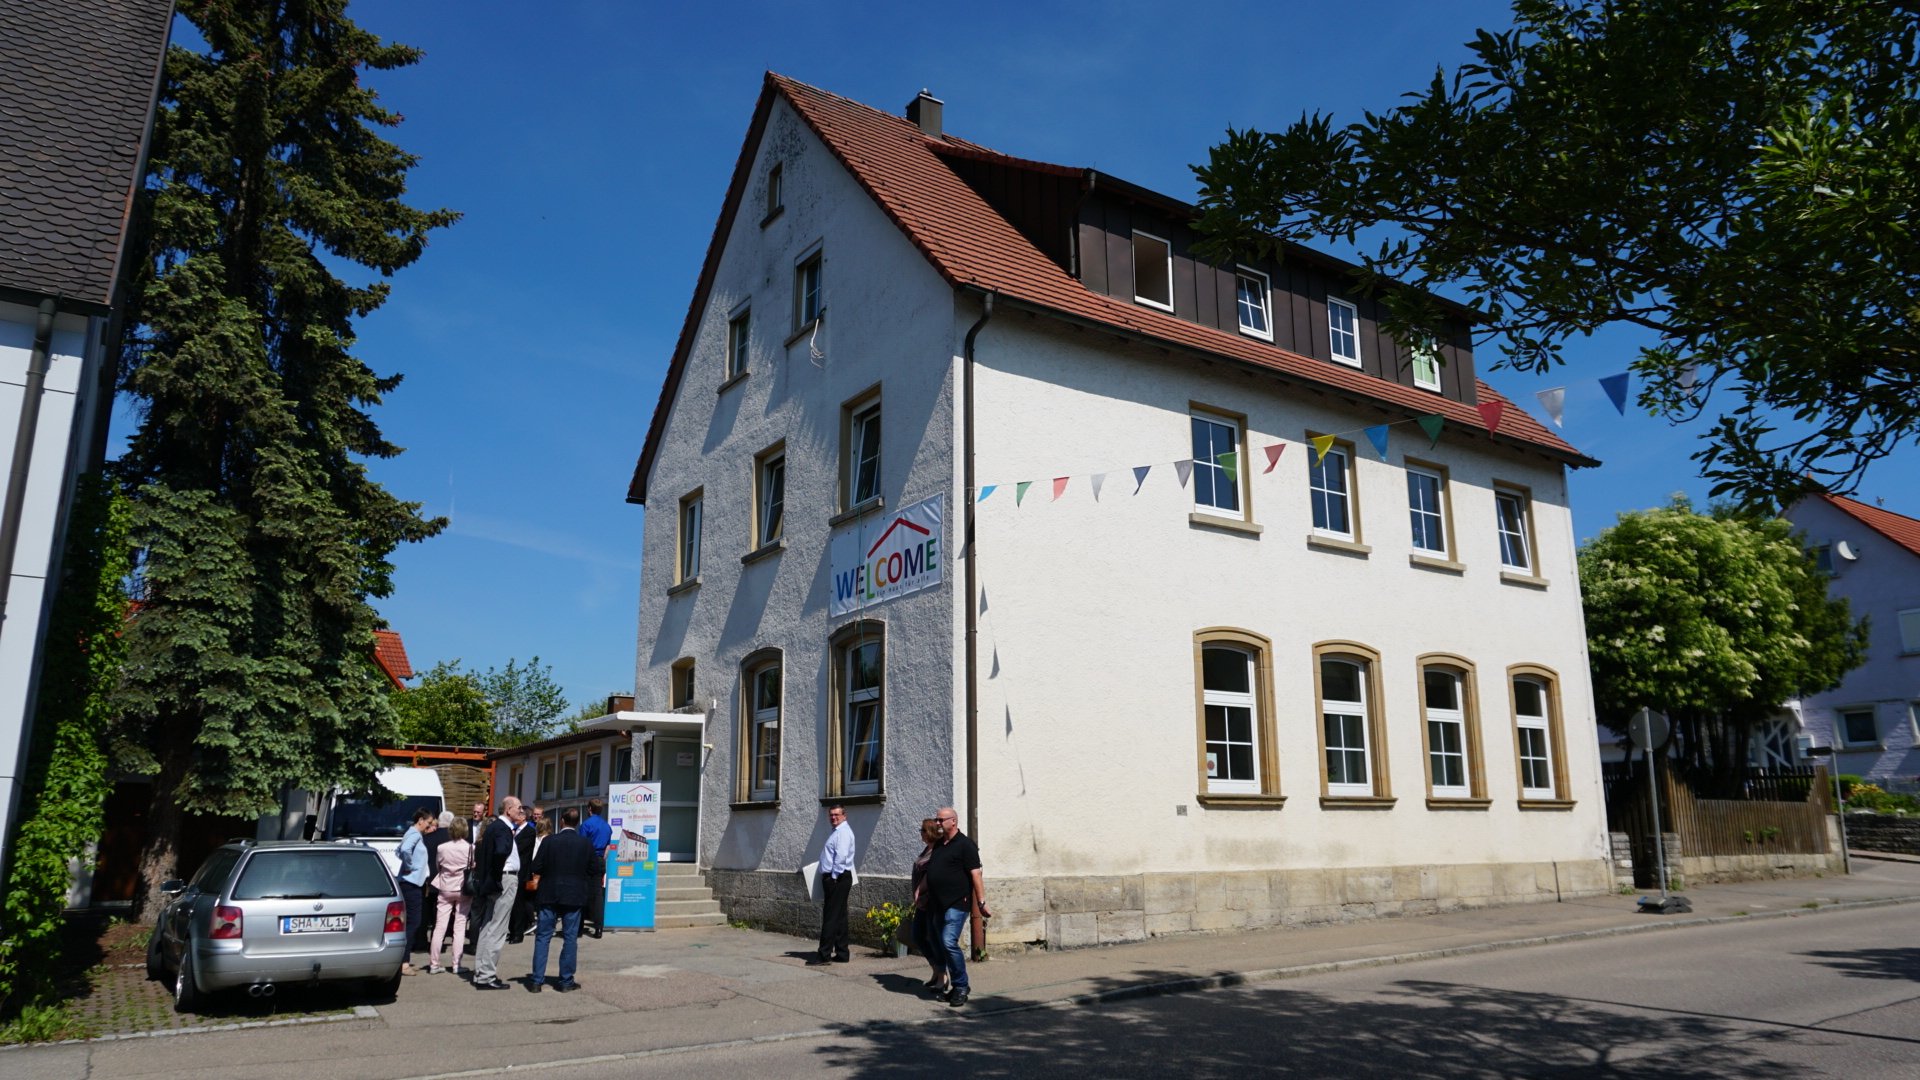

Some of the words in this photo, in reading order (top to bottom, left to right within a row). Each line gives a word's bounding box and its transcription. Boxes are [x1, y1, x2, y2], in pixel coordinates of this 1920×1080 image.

[836, 538, 937, 601] WELCOME
[611, 794, 657, 805] WELCOME
[291, 918, 312, 929] SHA
[319, 917, 334, 928] XL
[335, 917, 348, 928] 15
